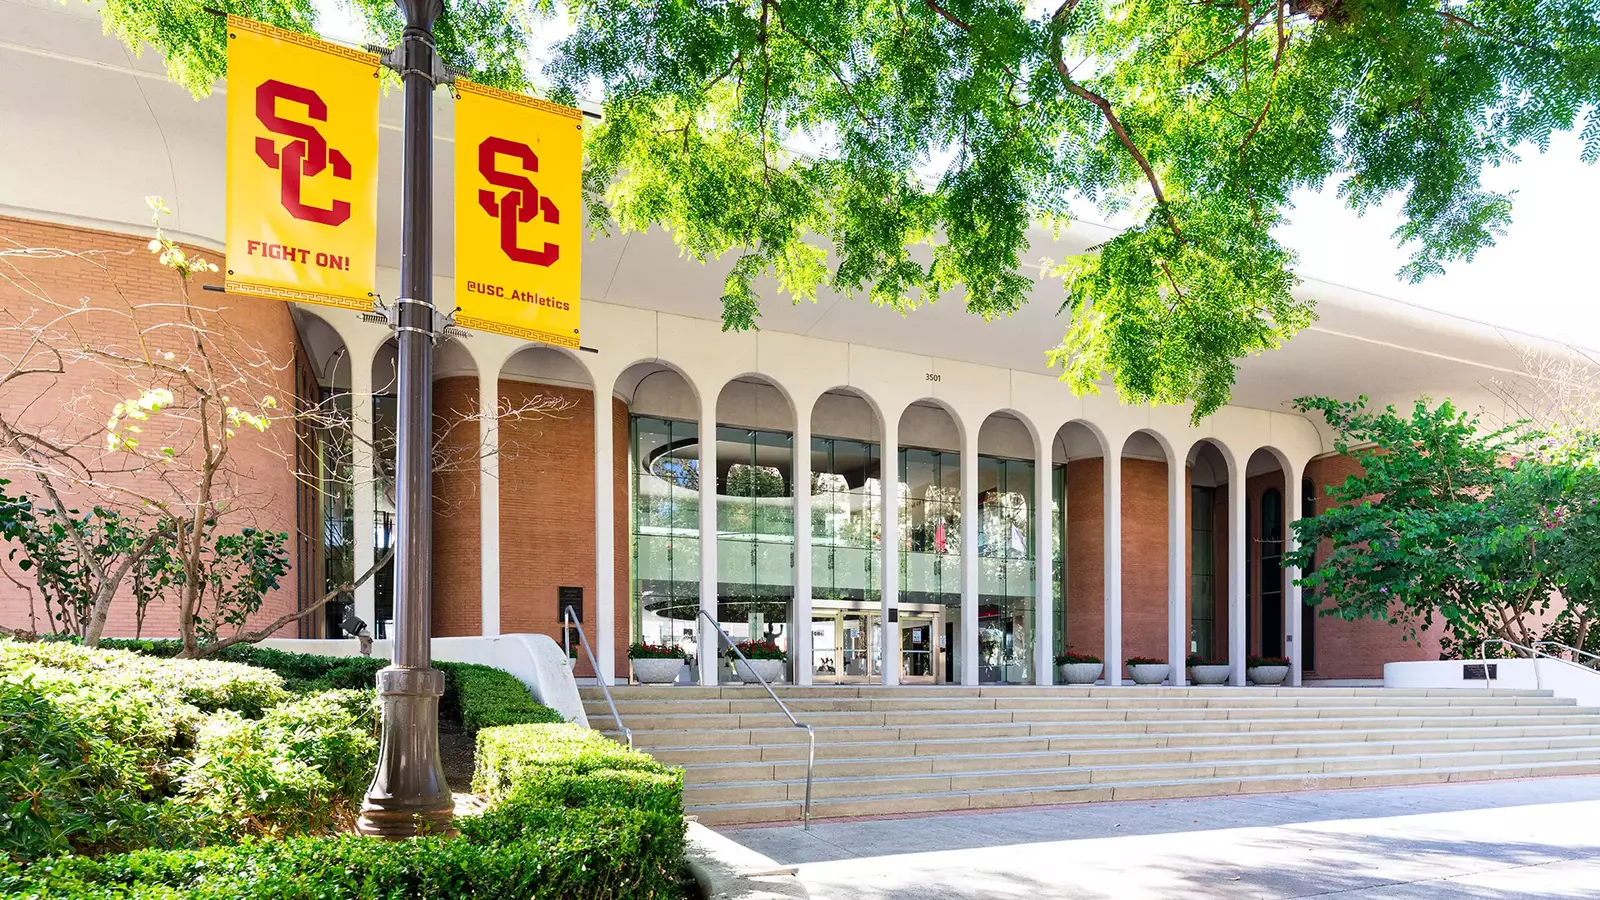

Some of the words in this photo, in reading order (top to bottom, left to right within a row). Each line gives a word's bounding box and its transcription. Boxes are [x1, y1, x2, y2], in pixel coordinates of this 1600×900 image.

[255, 78, 352, 227] SC
[478, 136, 560, 268] SC
[247, 240, 311, 264] FIGHT
[315, 252, 350, 271] ON!
[467, 280, 570, 311] @USC_Athletics
[925, 372, 941, 382] 3501
